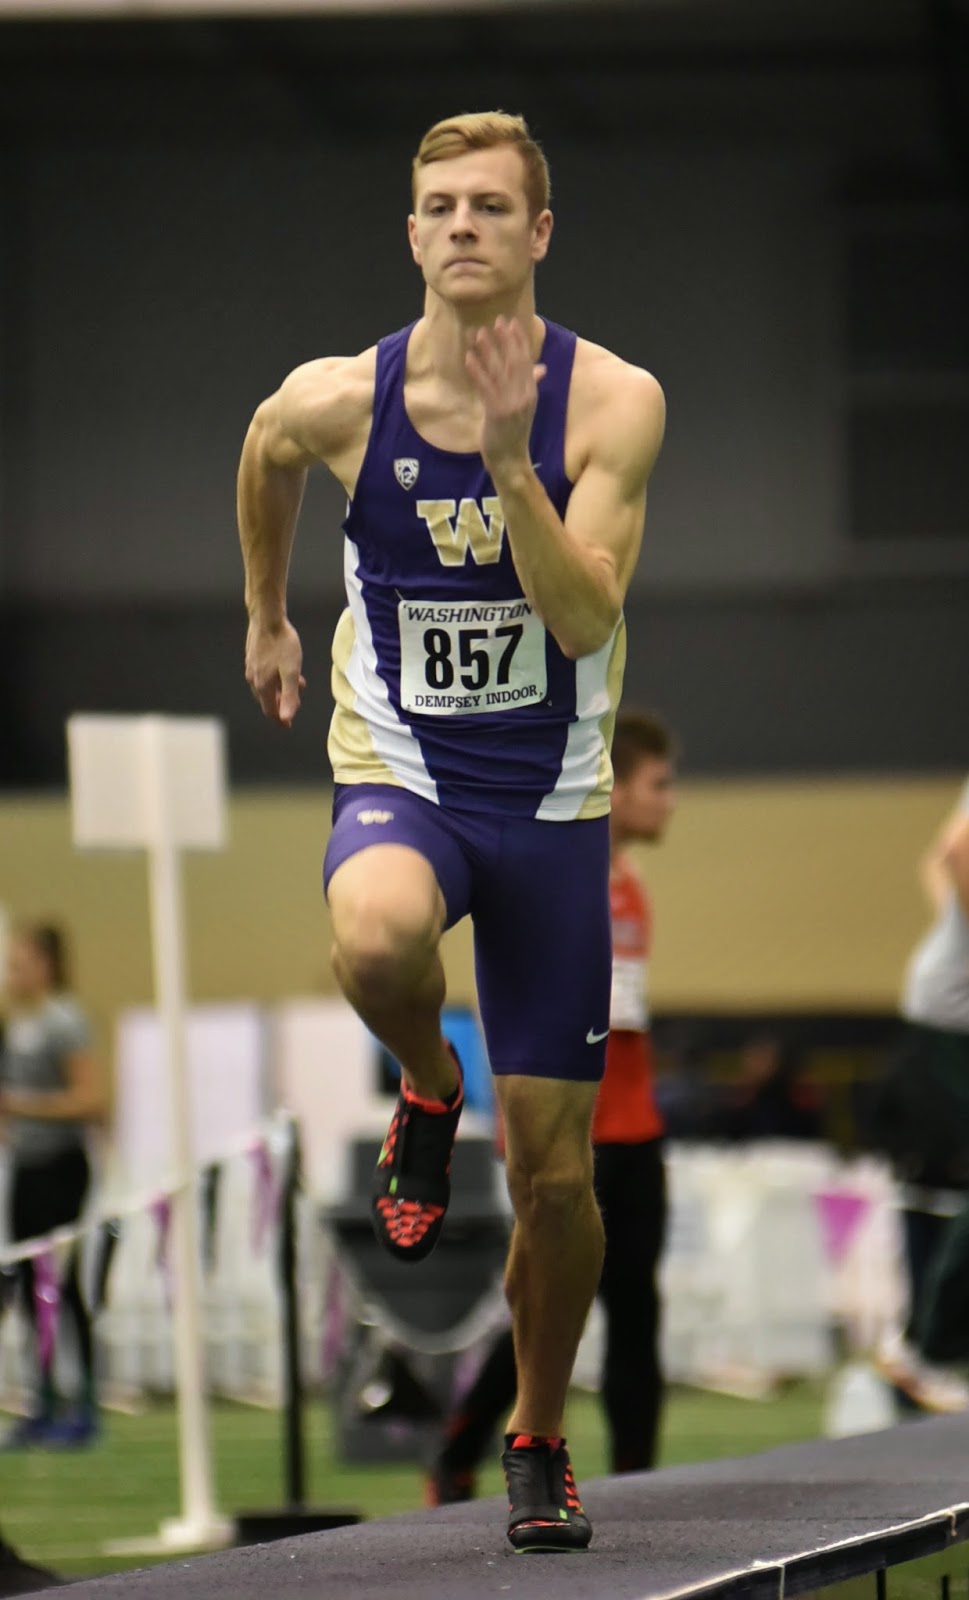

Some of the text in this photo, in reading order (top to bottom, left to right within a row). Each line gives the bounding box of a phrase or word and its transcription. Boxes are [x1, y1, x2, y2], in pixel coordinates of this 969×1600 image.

[416, 496, 505, 567] W
[407, 603, 533, 622] WASHINGTON
[423, 624, 524, 691] 857
[414, 684, 537, 709] DEMPSEY INDOOR
